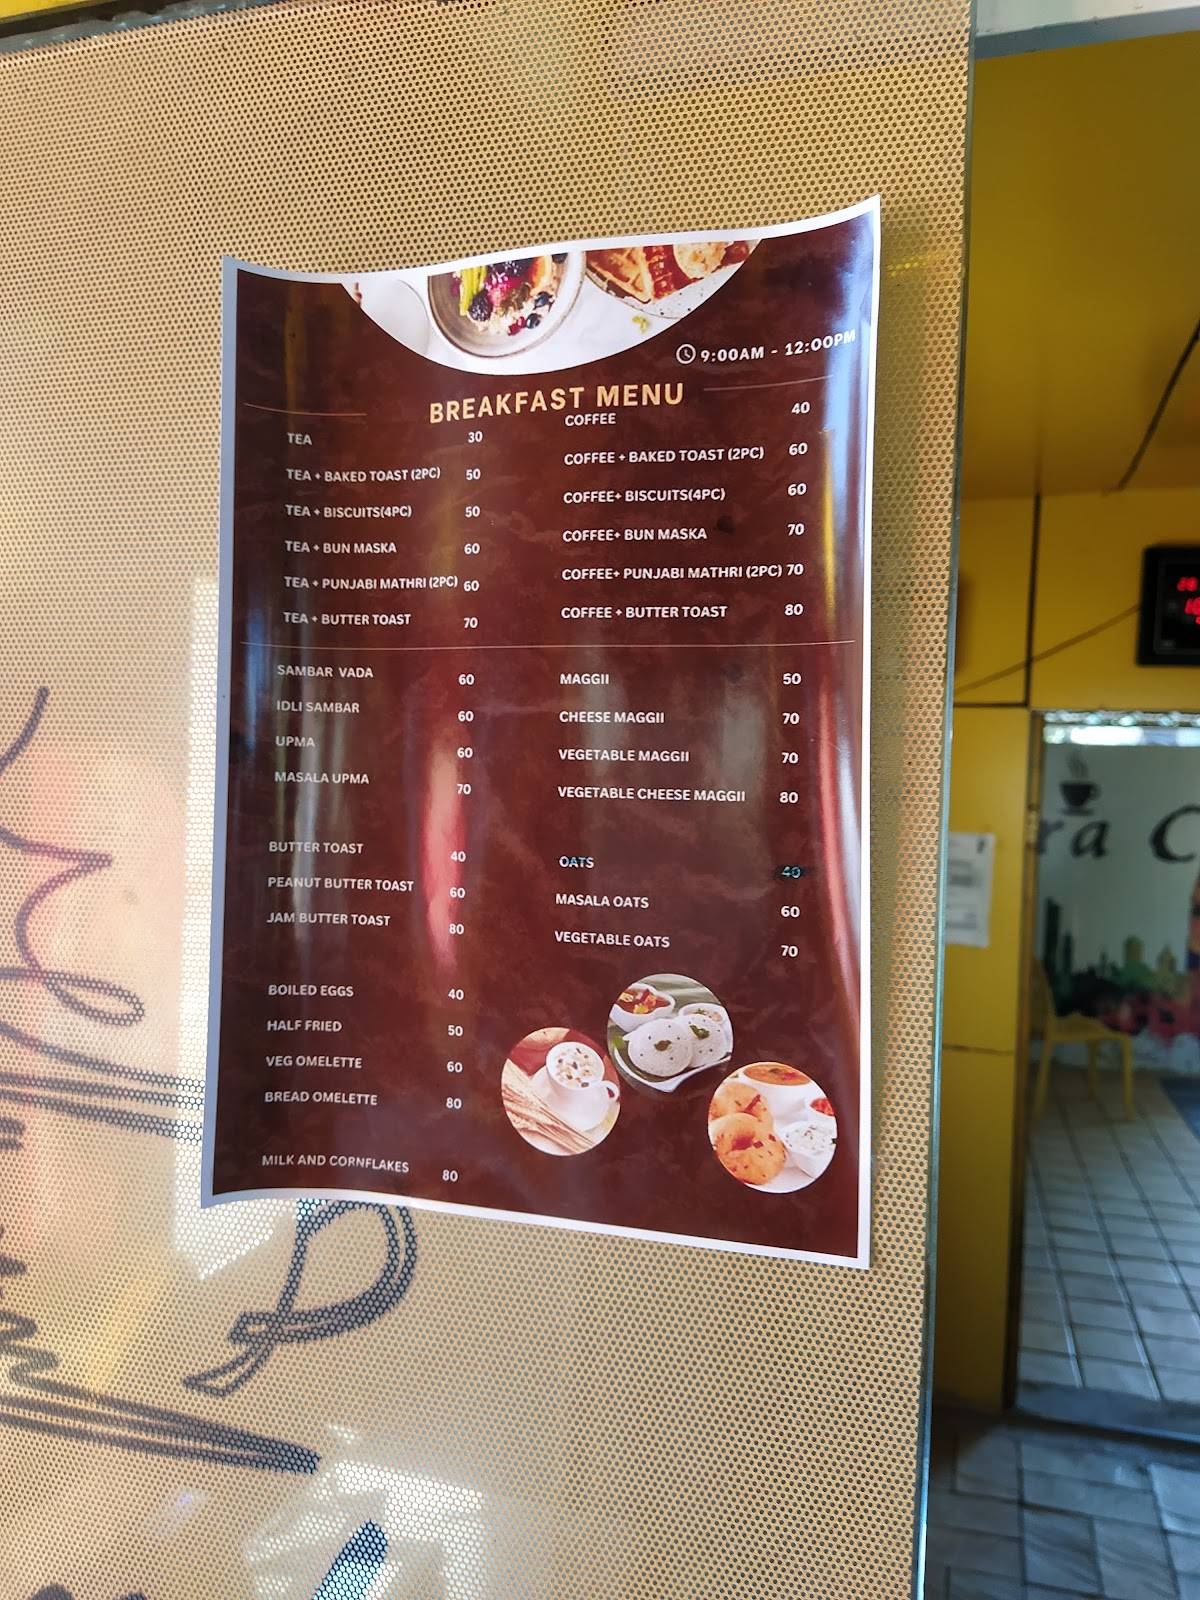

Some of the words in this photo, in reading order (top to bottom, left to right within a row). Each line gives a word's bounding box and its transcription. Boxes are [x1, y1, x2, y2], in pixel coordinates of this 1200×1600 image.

[700, 346, 765, 362] 9:00AM
[785, 329, 856, 356] 12:00PM
[429, 387, 585, 424] BREAKFAST
[596, 383, 683, 407] MENU
[565, 413, 616, 426] COFFEE
[792, 401, 810, 414] 40
[287, 433, 312, 445] TEA
[468, 431, 482, 442] 30
[564, 452, 615, 465] COFFEE
[628, 450, 676, 463] BAKED
[679, 449, 724, 461] TOAST
[728, 446, 764, 461] (2PC)
[788, 443, 807, 455] 60
[286, 469, 312, 481] TEA
[324, 471, 366, 482] BAKED
[370, 470, 408, 481] TOAST
[411, 467, 441, 481] (2PC)
[465, 469, 481, 480] 50
[563, 491, 622, 504] COFFEE+
[624, 488, 725, 502] BISCUITS(4PC)
[787, 483, 807, 496] 60
[285, 505, 311, 517] TEA
[324, 505, 412, 518] BISCUITS(4PC)
[465, 506, 480, 517] 50
[563, 529, 621, 542] COFFEE+
[624, 529, 654, 540] BUN
[658, 528, 707, 540] MASKA
[787, 523, 805, 536] 70
[285, 541, 310, 553] TEA
[323, 542, 351, 554] BUN
[353, 542, 397, 554] MASKA
[464, 543, 480, 555] 60
[562, 568, 620, 580] COFFEE+
[623, 567, 684, 580] PUNJABI
[687, 566, 743, 579] MATHRI
[746, 565, 782, 579] (2PC)
[786, 564, 804, 576] 70
[284, 576, 309, 588] TEA
[322, 578, 377, 590] PUNJABI
[380, 578, 427, 589] MATHRI
[429, 576, 458, 589] (2PC)
[463, 580, 479, 592] 60
[283, 612, 308, 624] TEA
[321, 614, 369, 625] BUTTER
[372, 614, 411, 625] TOAST
[464, 617, 478, 628] 70
[561, 606, 612, 619] COFFEE
[625, 606, 679, 618] BUTTER
[682, 605, 728, 617] TOAST
[784, 604, 803, 616] 80
[277, 664, 333, 678] SAMBAR
[339, 668, 374, 678] VADA
[458, 674, 474, 685] 60
[560, 674, 609, 685] MAGGII
[783, 673, 801, 684] 50
[276, 701, 302, 712] IDLI
[306, 702, 360, 714] SAMBAR
[458, 711, 474, 722] 60
[559, 712, 611, 723] CHEESE
[614, 712, 664, 724] MAGGII
[782, 713, 800, 724] 70
[275, 736, 315, 748] UPMA
[457, 747, 473, 758] 60
[559, 750, 635, 761] VEGETABLE
[638, 750, 689, 762] MAGGII
[781, 752, 798, 764] 70
[274, 772, 329, 784] MASALA
[332, 774, 369, 784] UPMA
[456, 784, 471, 795] 70
[558, 786, 634, 799] VEGETABLE
[637, 789, 690, 800] CHEESE
[694, 790, 745, 802] MAGGII
[779, 792, 798, 803] 80
[269, 841, 320, 853] BUTTER
[323, 842, 363, 854] TOAST
[450, 851, 466, 862] 40
[559, 856, 594, 868] OATS
[268, 877, 321, 888] PEANUT
[324, 878, 372, 890] BUTTER
[375, 880, 414, 892] TOAST
[450, 887, 465, 898] 60
[556, 894, 610, 907] MASALA
[613, 896, 649, 908] OATS
[780, 906, 800, 917] 60
[267, 912, 295, 924] JAM
[299, 913, 348, 924] BUTTER
[351, 914, 390, 926] TOAST
[449, 924, 464, 934] 80
[555, 931, 631, 946] VEGETABLE
[634, 935, 670, 948] OATS
[781, 945, 798, 956] 70
[268, 984, 317, 996] BOILED
[320, 985, 354, 997] EGGS
[448, 989, 464, 1000] 40
[267, 1020, 302, 1031] HALF
[304, 1020, 342, 1032] FRIED
[448, 1025, 463, 1036] 50
[266, 1056, 293, 1067] VEG
[296, 1056, 362, 1068] OMELETTE
[447, 1062, 463, 1073] 60
[264, 1092, 310, 1102] BREAD
[312, 1092, 378, 1105] OMELETTE
[446, 1098, 462, 1109] 80
[262, 1154, 294, 1166] MILK
[298, 1155, 326, 1166] AND
[329, 1156, 409, 1172] CORNFLAKES
[442, 1170, 458, 1181] 80
